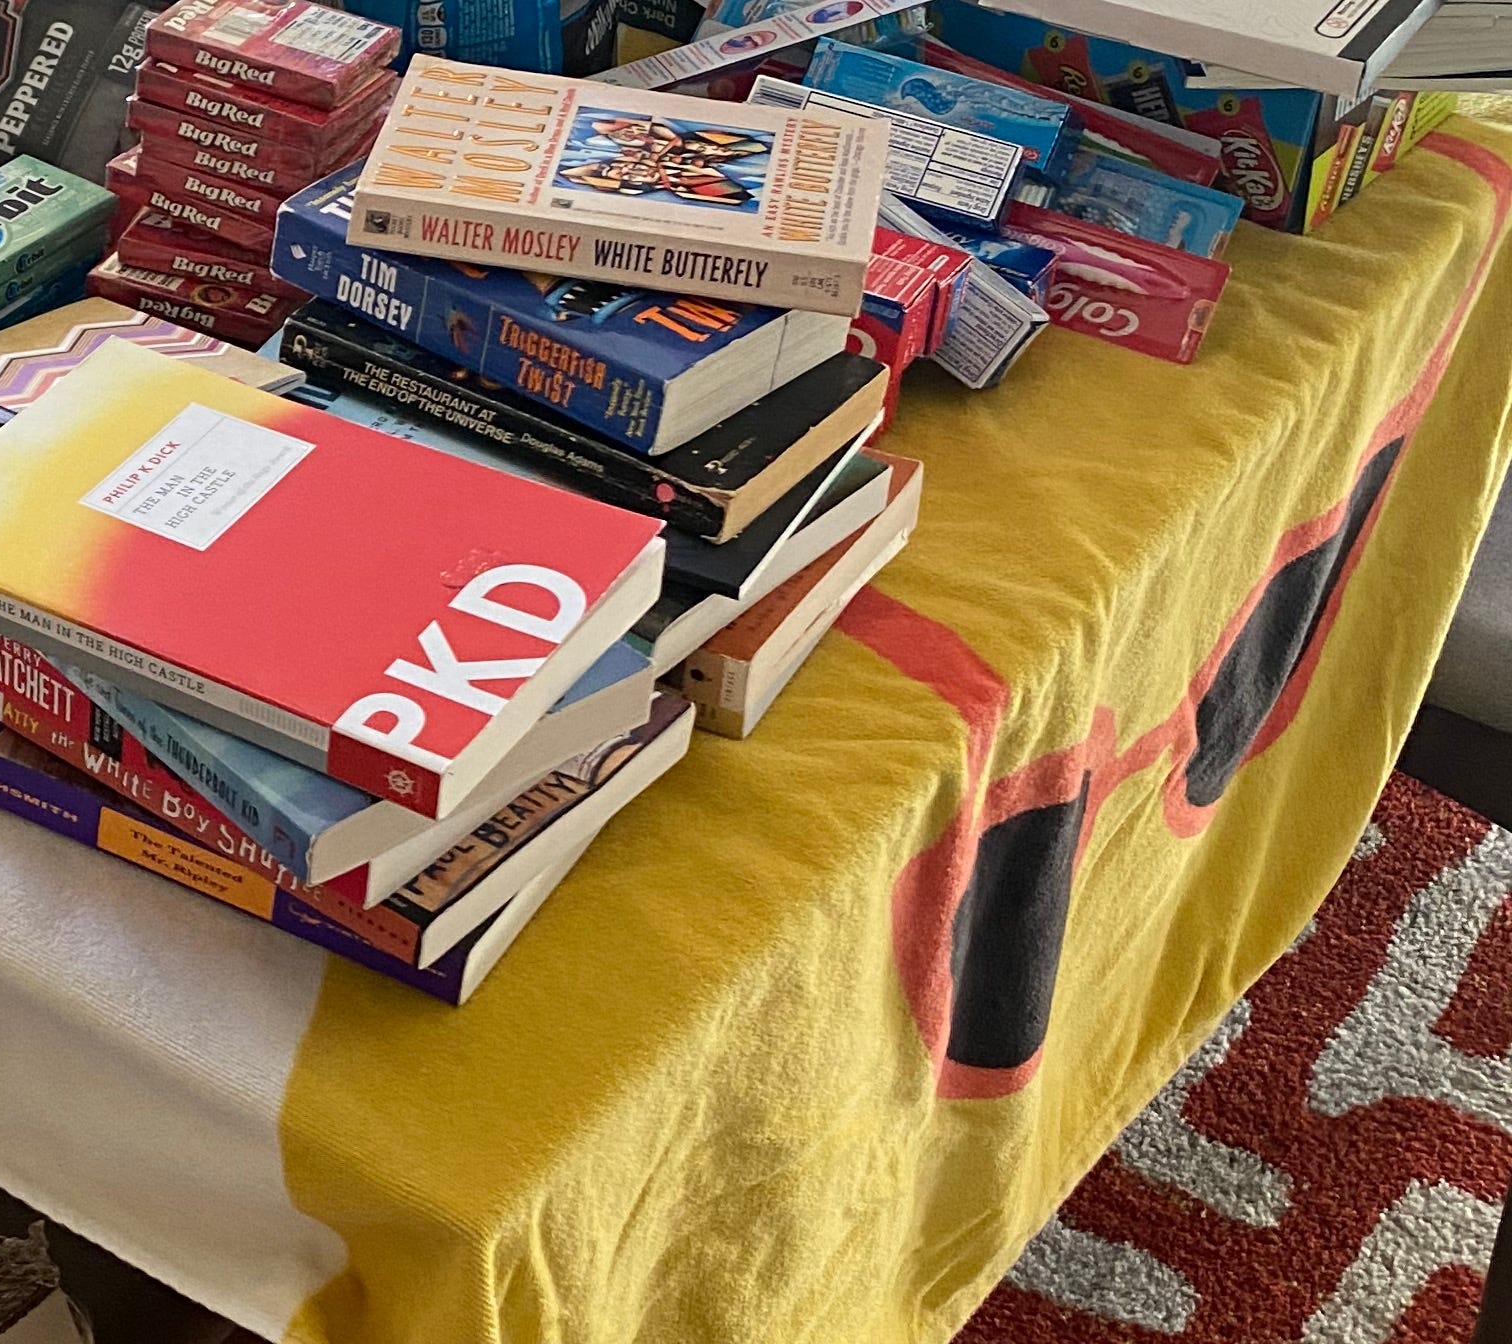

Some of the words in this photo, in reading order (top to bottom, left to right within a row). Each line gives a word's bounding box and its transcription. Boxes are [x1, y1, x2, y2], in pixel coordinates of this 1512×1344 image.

[1049, 37, 1060, 49] 6
[1133, 67, 1143, 79] 6
[372, 67, 487, 188] WALTER
[1223, 99, 1233, 112] 6
[449, 76, 557, 202] MOSLEY
[780, 117, 797, 151] MYSTERY
[789, 118, 842, 193] BUTTERFLY
[771, 153, 788, 195] RAWLINS
[766, 200, 779, 222] EASY
[778, 196, 827, 242] WHITE
[360, 253, 397, 293] TIM
[421, 214, 494, 251] WALTER
[501, 226, 580, 262] MOSLEY
[594, 239, 656, 274] WHITE
[661, 248, 768, 288] BUTTERFLY
[337, 276, 413, 331] DORSEY
[342, 367, 369, 387] THE
[369, 376, 396, 398] END
[397, 388, 419, 404] OF
[417, 396, 446, 417] THE
[444, 407, 515, 444] UNIVERSE
[364, 361, 389, 379] THE
[391, 372, 479, 416] RESTAURANT
[478, 408, 497, 422] AT
[102, 473, 141, 504] PHILIP
[138, 464, 152, 474] K
[148, 440, 181, 465] DICK
[520, 432, 565, 458] Douglas
[565, 451, 605, 473] Adams
[133, 495, 160, 515] THE
[157, 474, 185, 497] MAN
[165, 504, 197, 529] HIGH
[195, 469, 236, 505] CASTLE
[176, 484, 193, 498] IN
[190, 466, 218, 485] THE
[20, 607, 52, 631] MAN
[56, 624, 71, 638] IN
[75, 631, 104, 653] THE
[109, 645, 144, 670] HIGH
[148, 662, 205, 695] CASTLE
[331, 563, 587, 775] PKD
[166, 733, 239, 810] THUNDERBOLT
[129, 829, 164, 847] The
[166, 839, 244, 885] Talented
[140, 848, 170, 869] Mr.
[170, 861, 231, 895] Ripley
